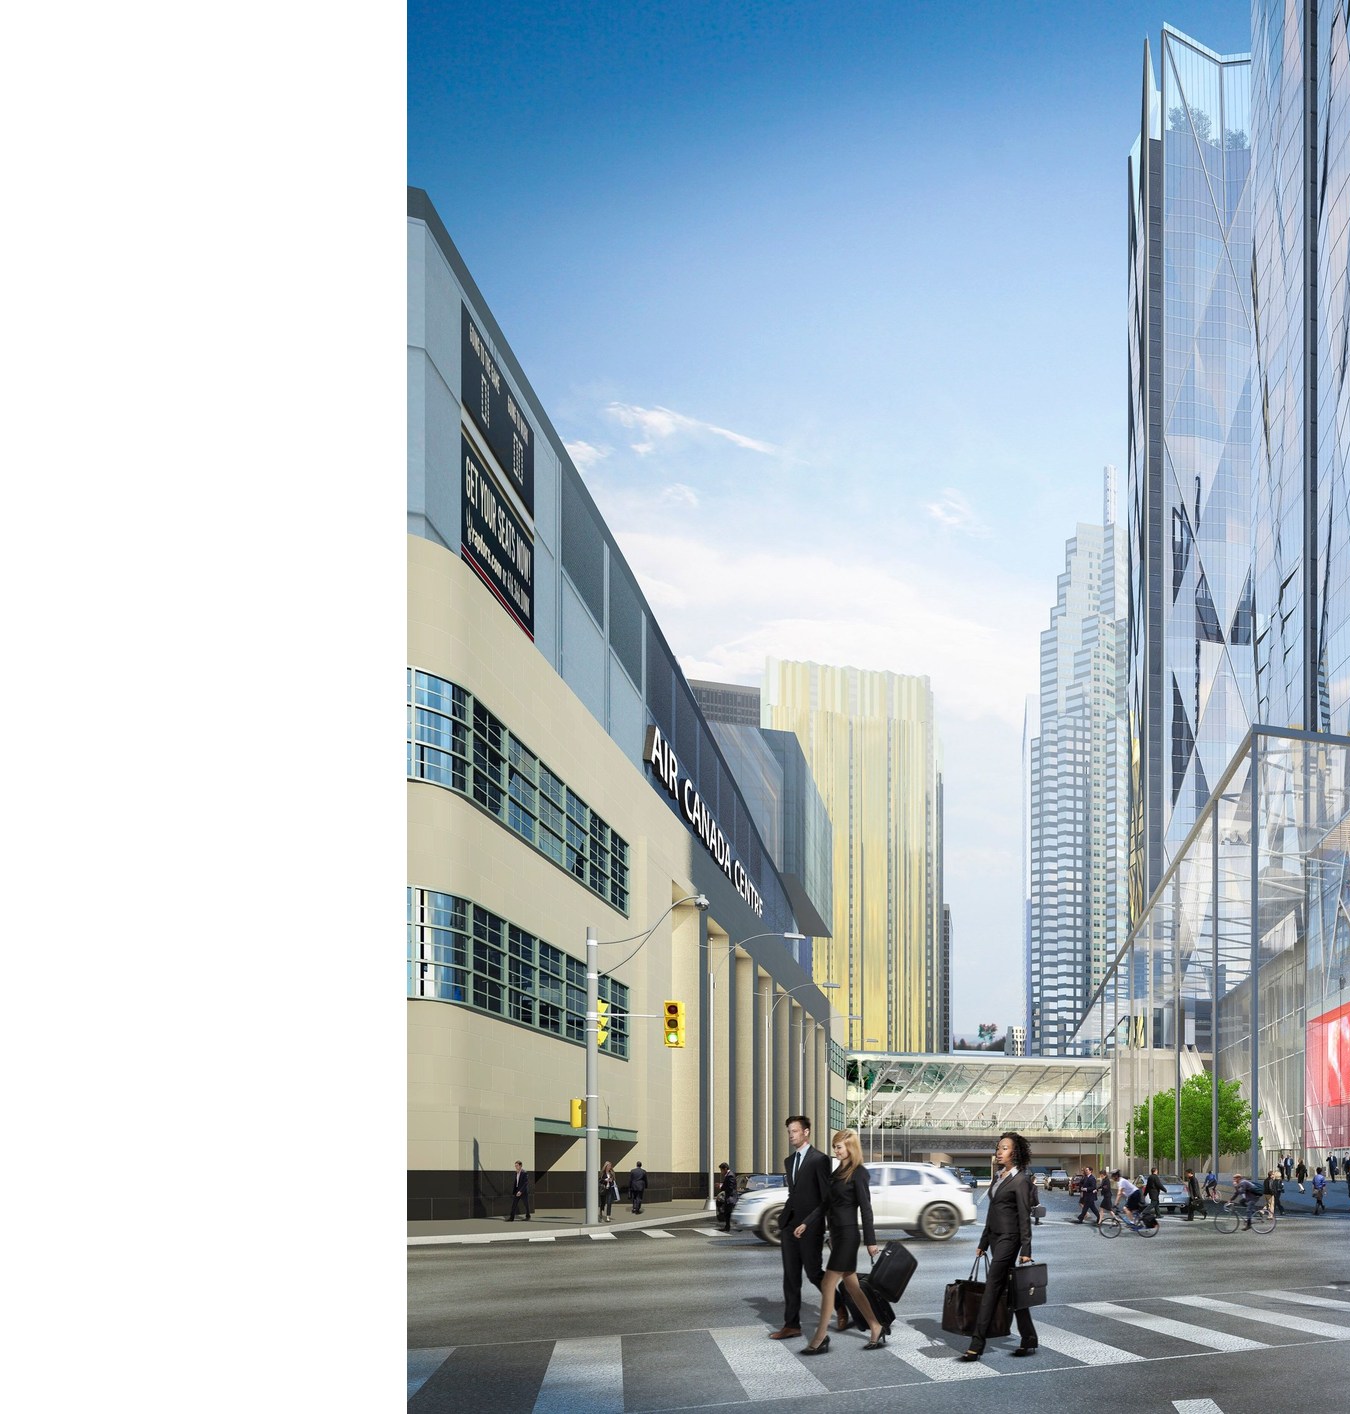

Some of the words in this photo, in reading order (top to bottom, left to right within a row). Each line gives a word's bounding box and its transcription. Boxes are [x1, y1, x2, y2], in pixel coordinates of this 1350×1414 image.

[465, 455, 479, 509] GET
[479, 475, 497, 537] YOUR
[497, 505, 516, 564] SEATS
[516, 531, 531, 587] NOW!
[472, 526, 502, 580] raptors.com
[502, 566, 507, 587] or
[651, 725, 679, 800] AIR
[684, 778, 732, 880] CANADA
